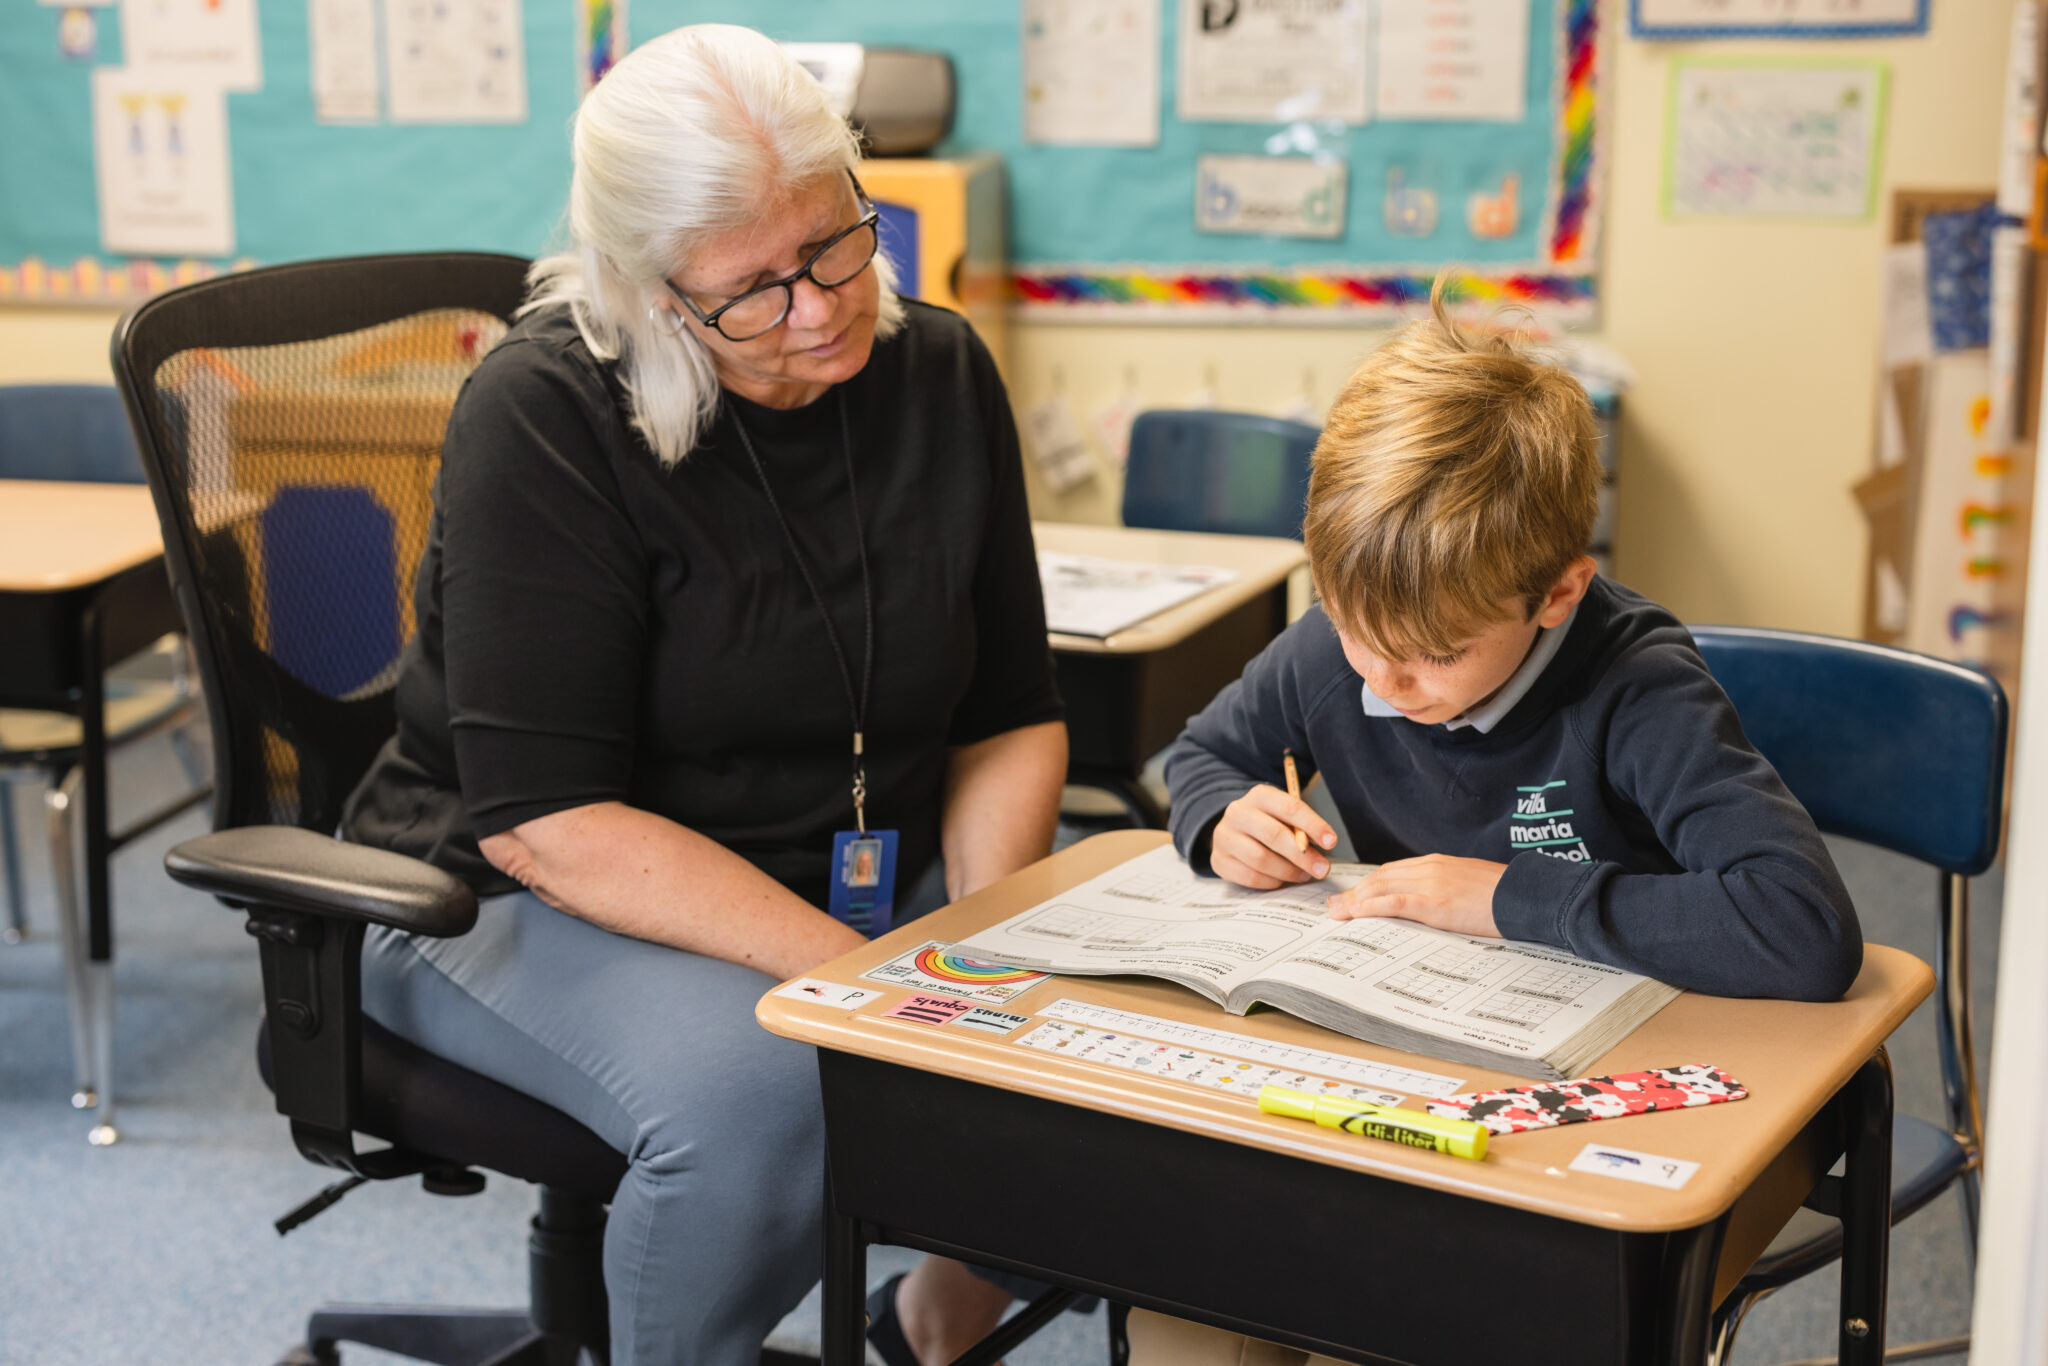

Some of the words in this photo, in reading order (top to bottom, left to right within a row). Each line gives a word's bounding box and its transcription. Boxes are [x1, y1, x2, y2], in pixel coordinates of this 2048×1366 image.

[1510, 818, 1574, 842] maria
[1339, 937, 1378, 952] Subtract
[1302, 959, 1340, 972] Subtract
[1521, 952, 1569, 966] SOLVING
[1192, 963, 1227, 976] Algebra
[1429, 969, 1469, 982] Subtract
[1571, 961, 1624, 977] PROBLEM
[841, 992, 865, 1002] d
[939, 985, 973, 998] Friends
[1392, 989, 1433, 1005] Subtract
[1520, 989, 1563, 1002] Subtract
[912, 997, 969, 1012] equals
[973, 1007, 1029, 1024] minus
[1485, 1015, 1527, 1028] Subtract
[1463, 1032, 1486, 1041] Own
[1488, 1038, 1510, 1048] Your
